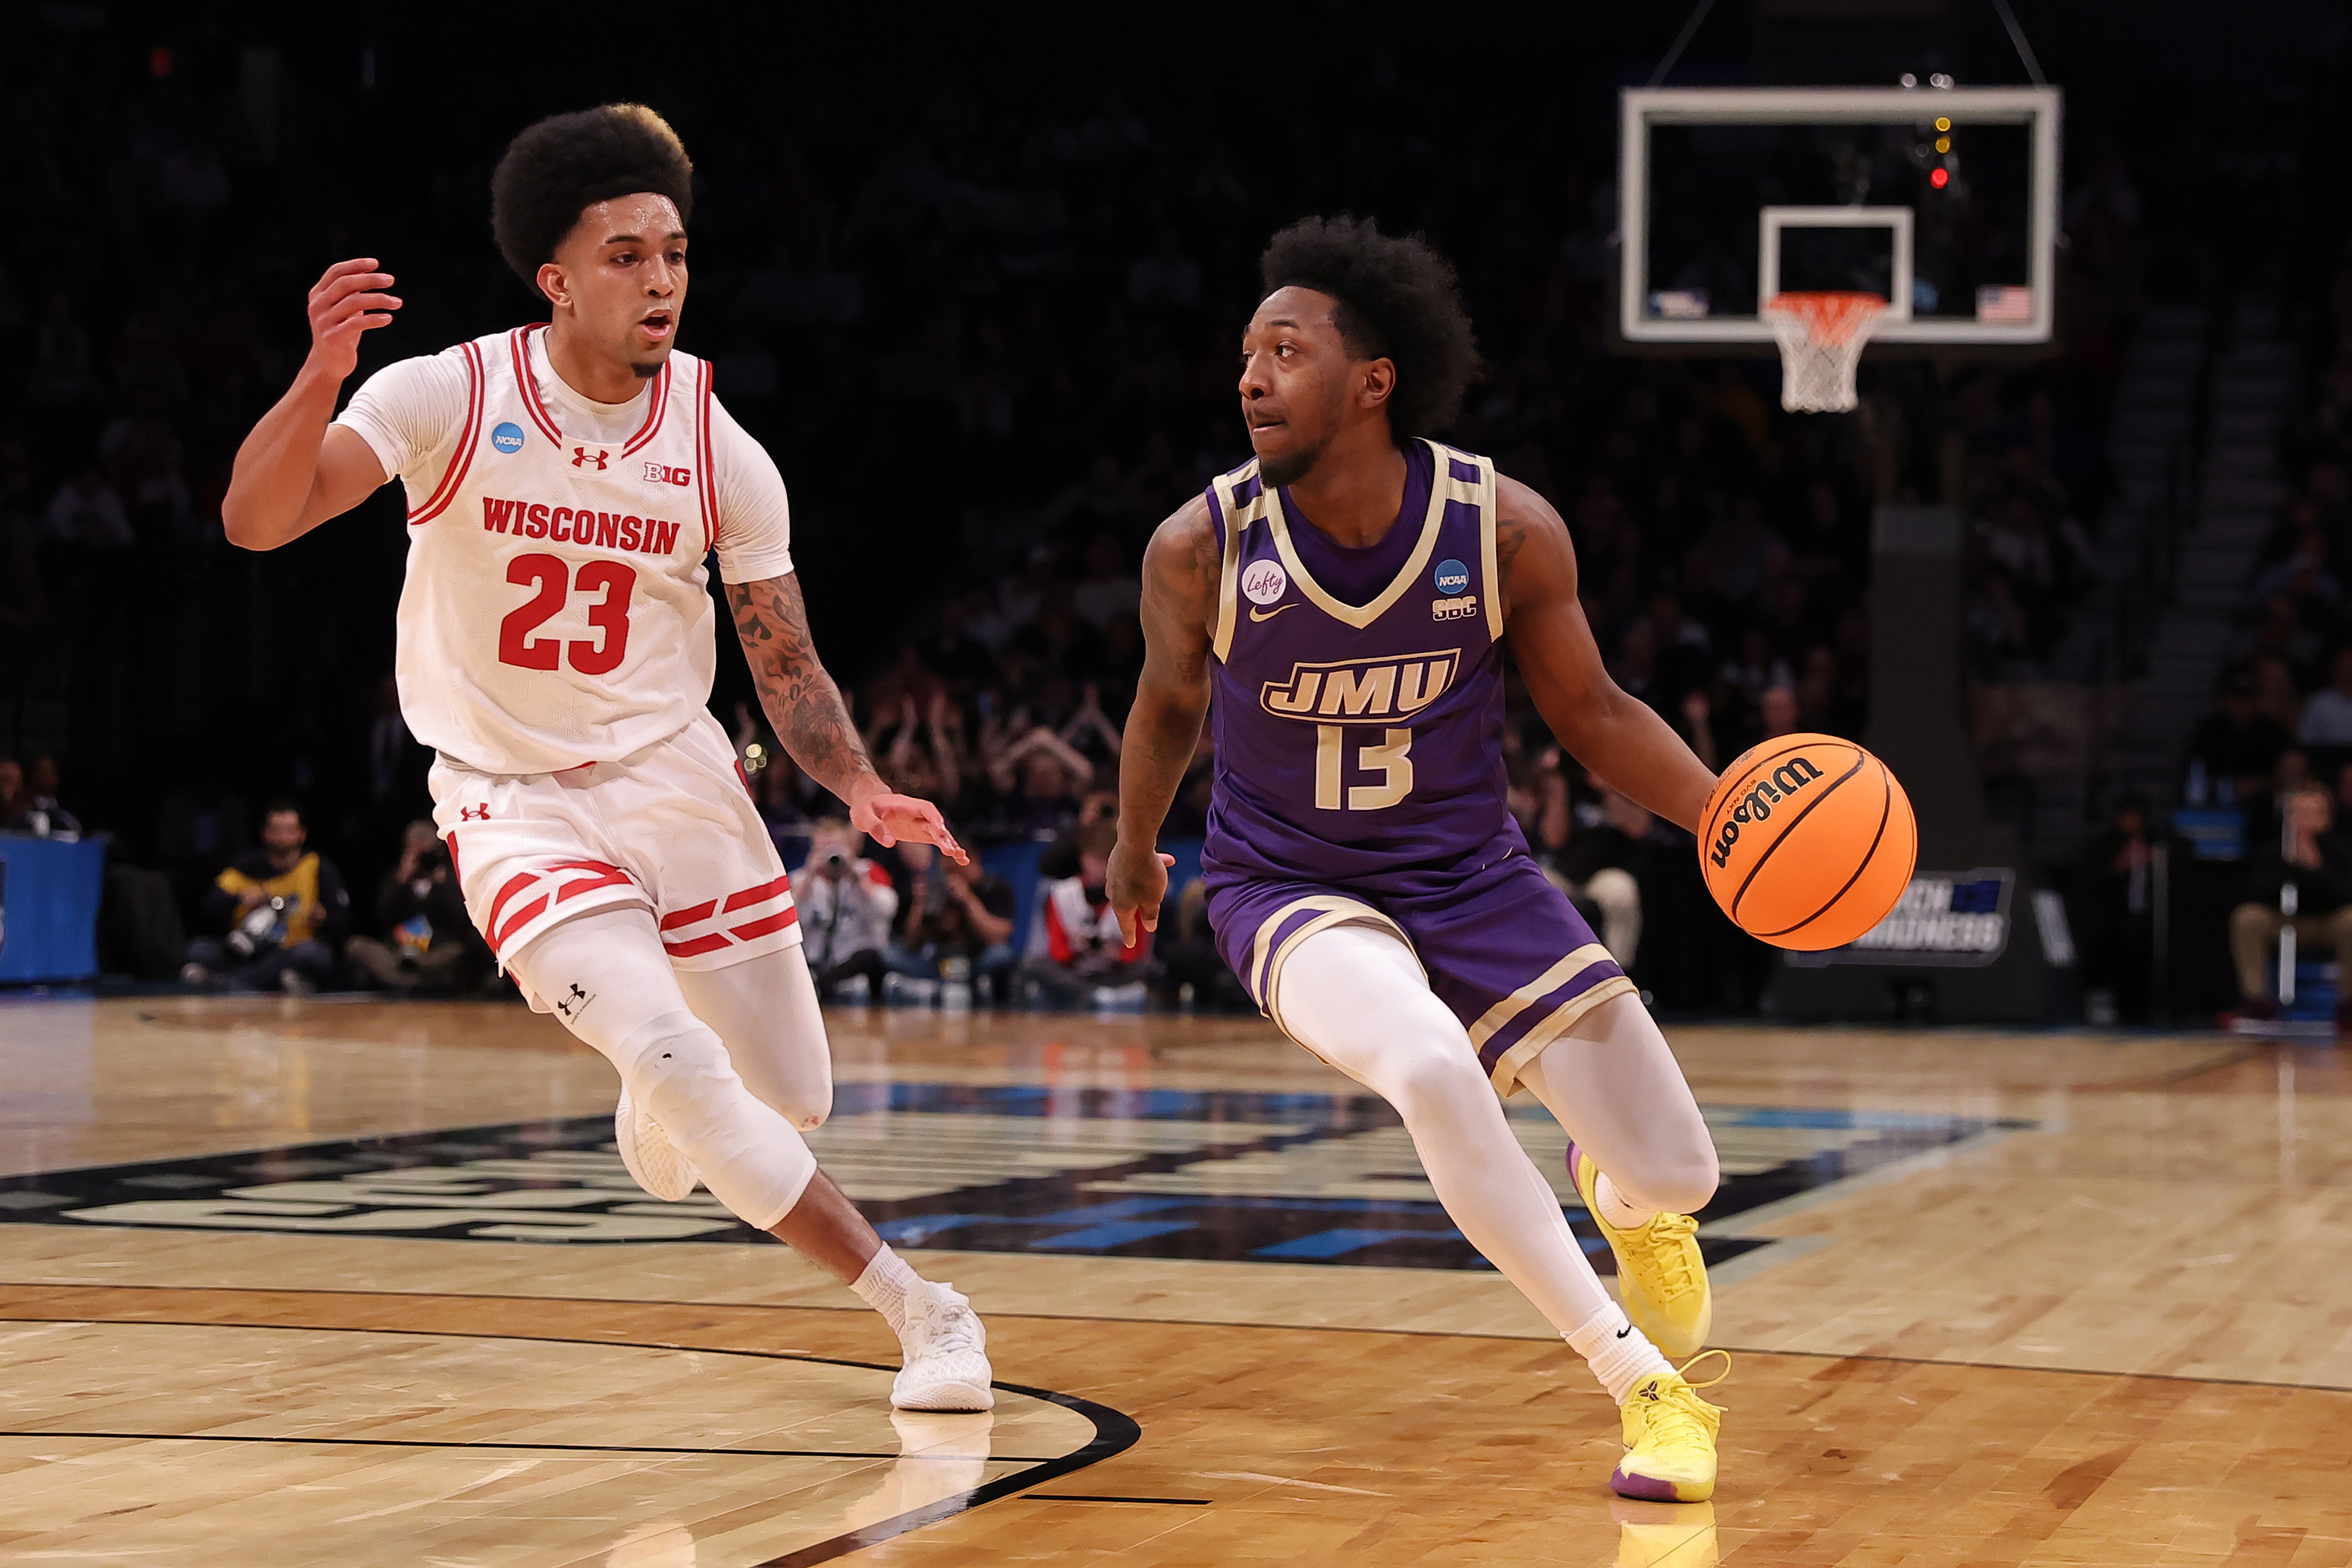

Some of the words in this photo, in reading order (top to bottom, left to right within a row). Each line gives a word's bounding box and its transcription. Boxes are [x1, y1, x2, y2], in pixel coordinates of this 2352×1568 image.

[495, 435, 522, 446] NCAA
[483, 497, 680, 554] WISCONSIN
[1248, 571, 1283, 596] Lefty
[1439, 575, 1468, 586] NCAA
[499, 553, 636, 675] 23
[1433, 596, 1476, 621] SBC
[1268, 659, 1450, 715] JMU
[1315, 724, 1413, 811] 13
[1740, 780, 1756, 795] EVO
[1711, 757, 1825, 869] Wilson
[1726, 797, 1740, 815] NXT
